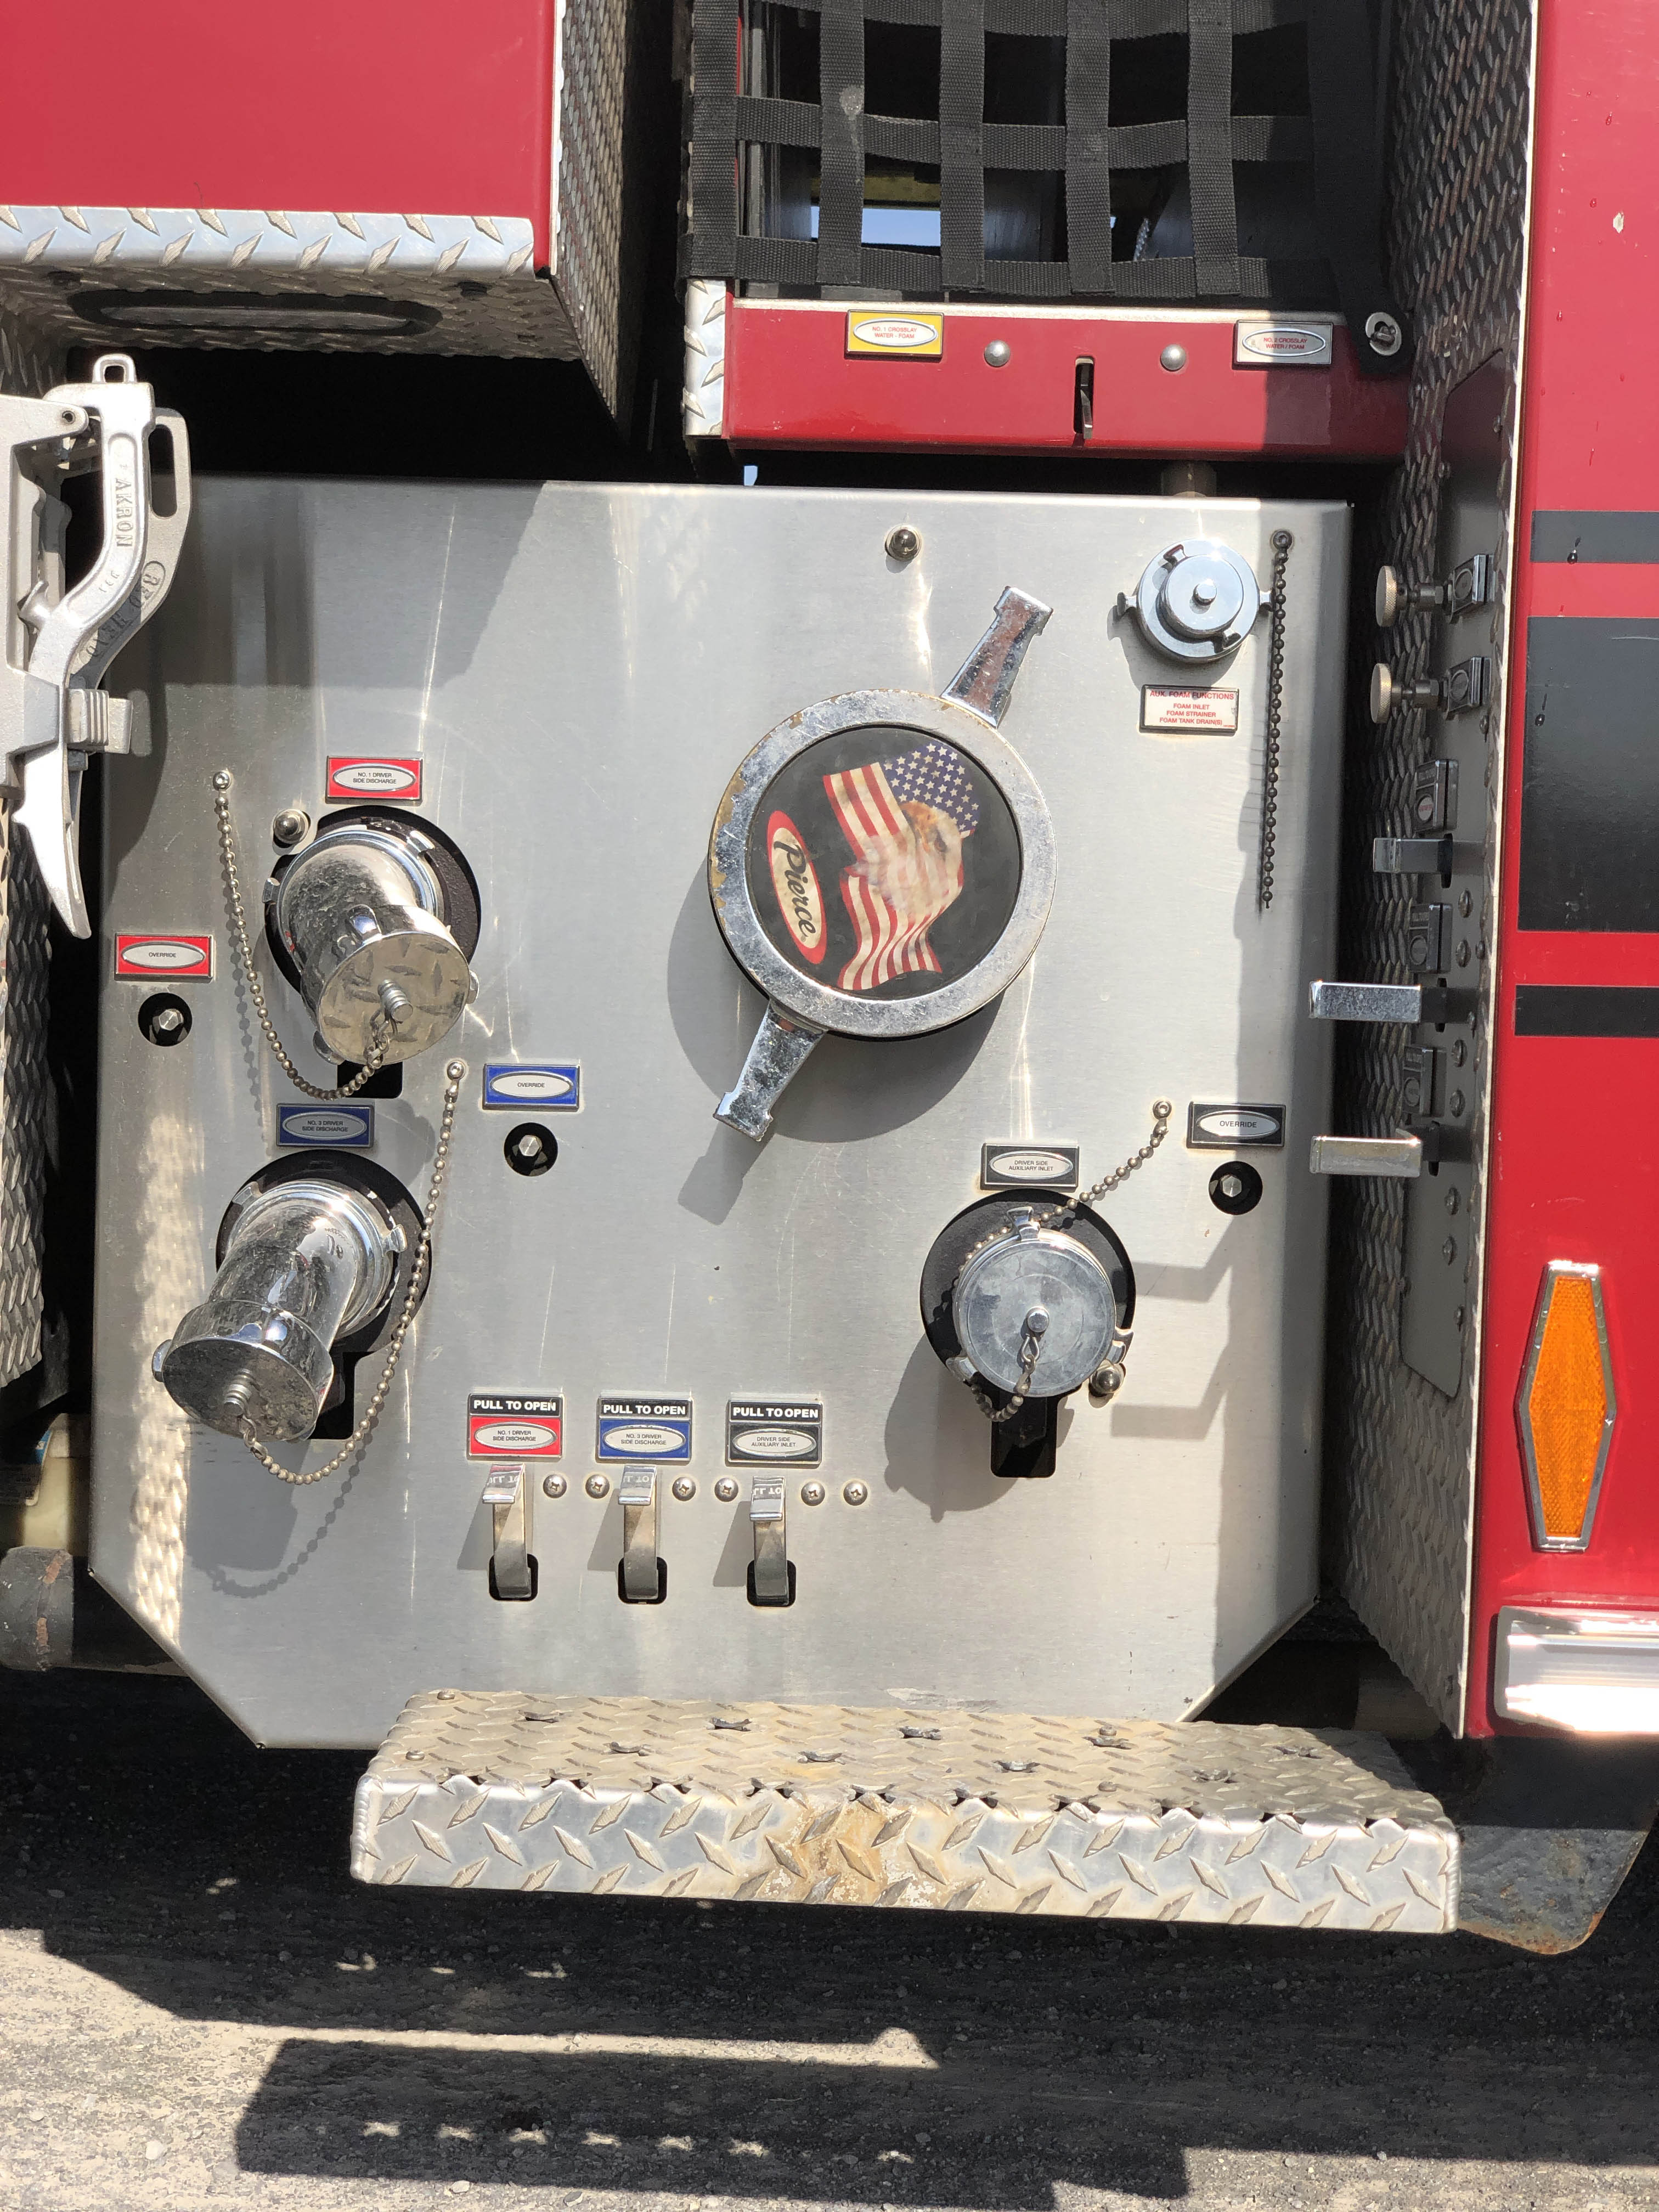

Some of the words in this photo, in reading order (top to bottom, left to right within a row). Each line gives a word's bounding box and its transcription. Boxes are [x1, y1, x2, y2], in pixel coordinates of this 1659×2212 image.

[115, 477, 134, 548] AKRON
[1192, 692, 1234, 700] FUNCTIONS
[773, 840, 816, 938] Pierce
[473, 1400, 503, 1409] PULL
[506, 1401, 522, 1410] TO
[524, 1401, 556, 1411] OPEN
[603, 1404, 633, 1414] PULL
[635, 1405, 651, 1414] TO
[653, 1406, 686, 1415] OPEN
[733, 1407, 764, 1417] PULL
[766, 1408, 783, 1417] TO
[785, 1408, 819, 1418] OPEN
